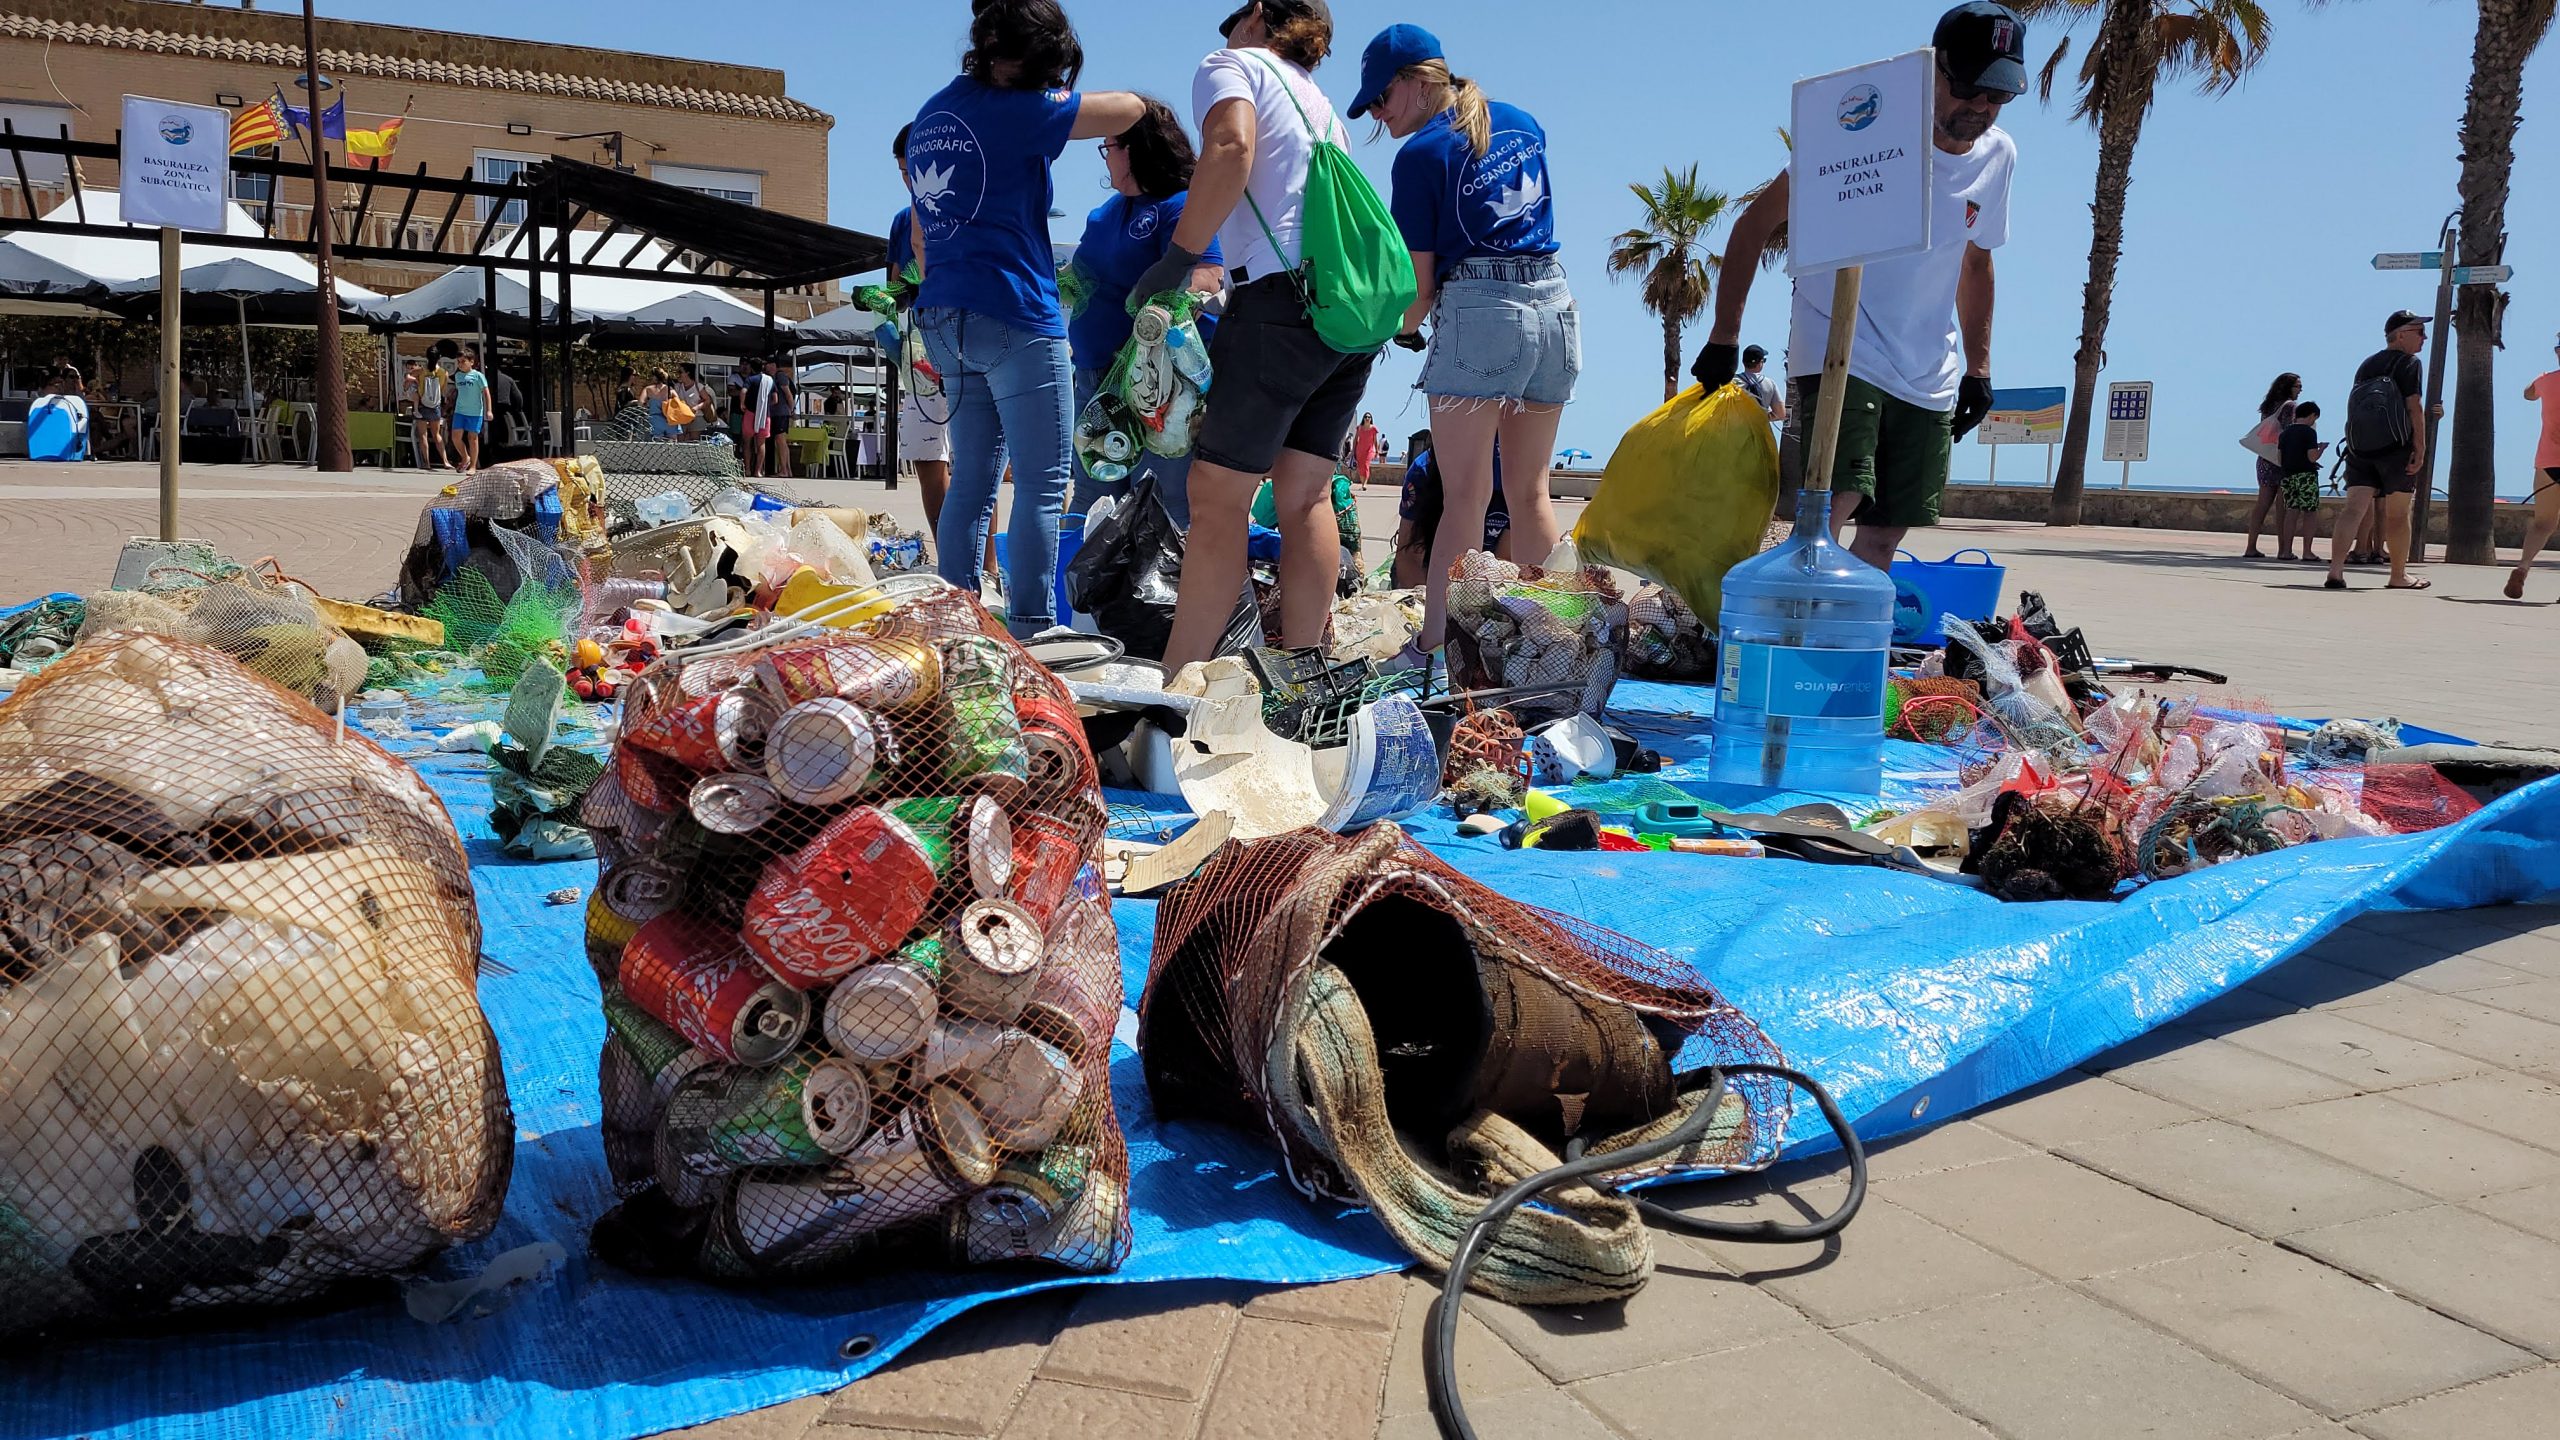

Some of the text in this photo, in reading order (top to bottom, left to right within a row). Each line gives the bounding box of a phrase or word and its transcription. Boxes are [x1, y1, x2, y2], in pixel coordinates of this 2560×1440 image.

[909, 136, 974, 159] CEANOGRÀFIC
[1471, 136, 1523, 172] FUNDACIÓN
[143, 157, 209, 173] BASURALEZA
[1819, 147, 1904, 177] BASURALEZA
[163, 169, 192, 180] ZONA
[1843, 168, 1881, 186] ZONA
[140, 176, 211, 193] SUBACUATICA
[1838, 183, 1884, 202] DUNAR
